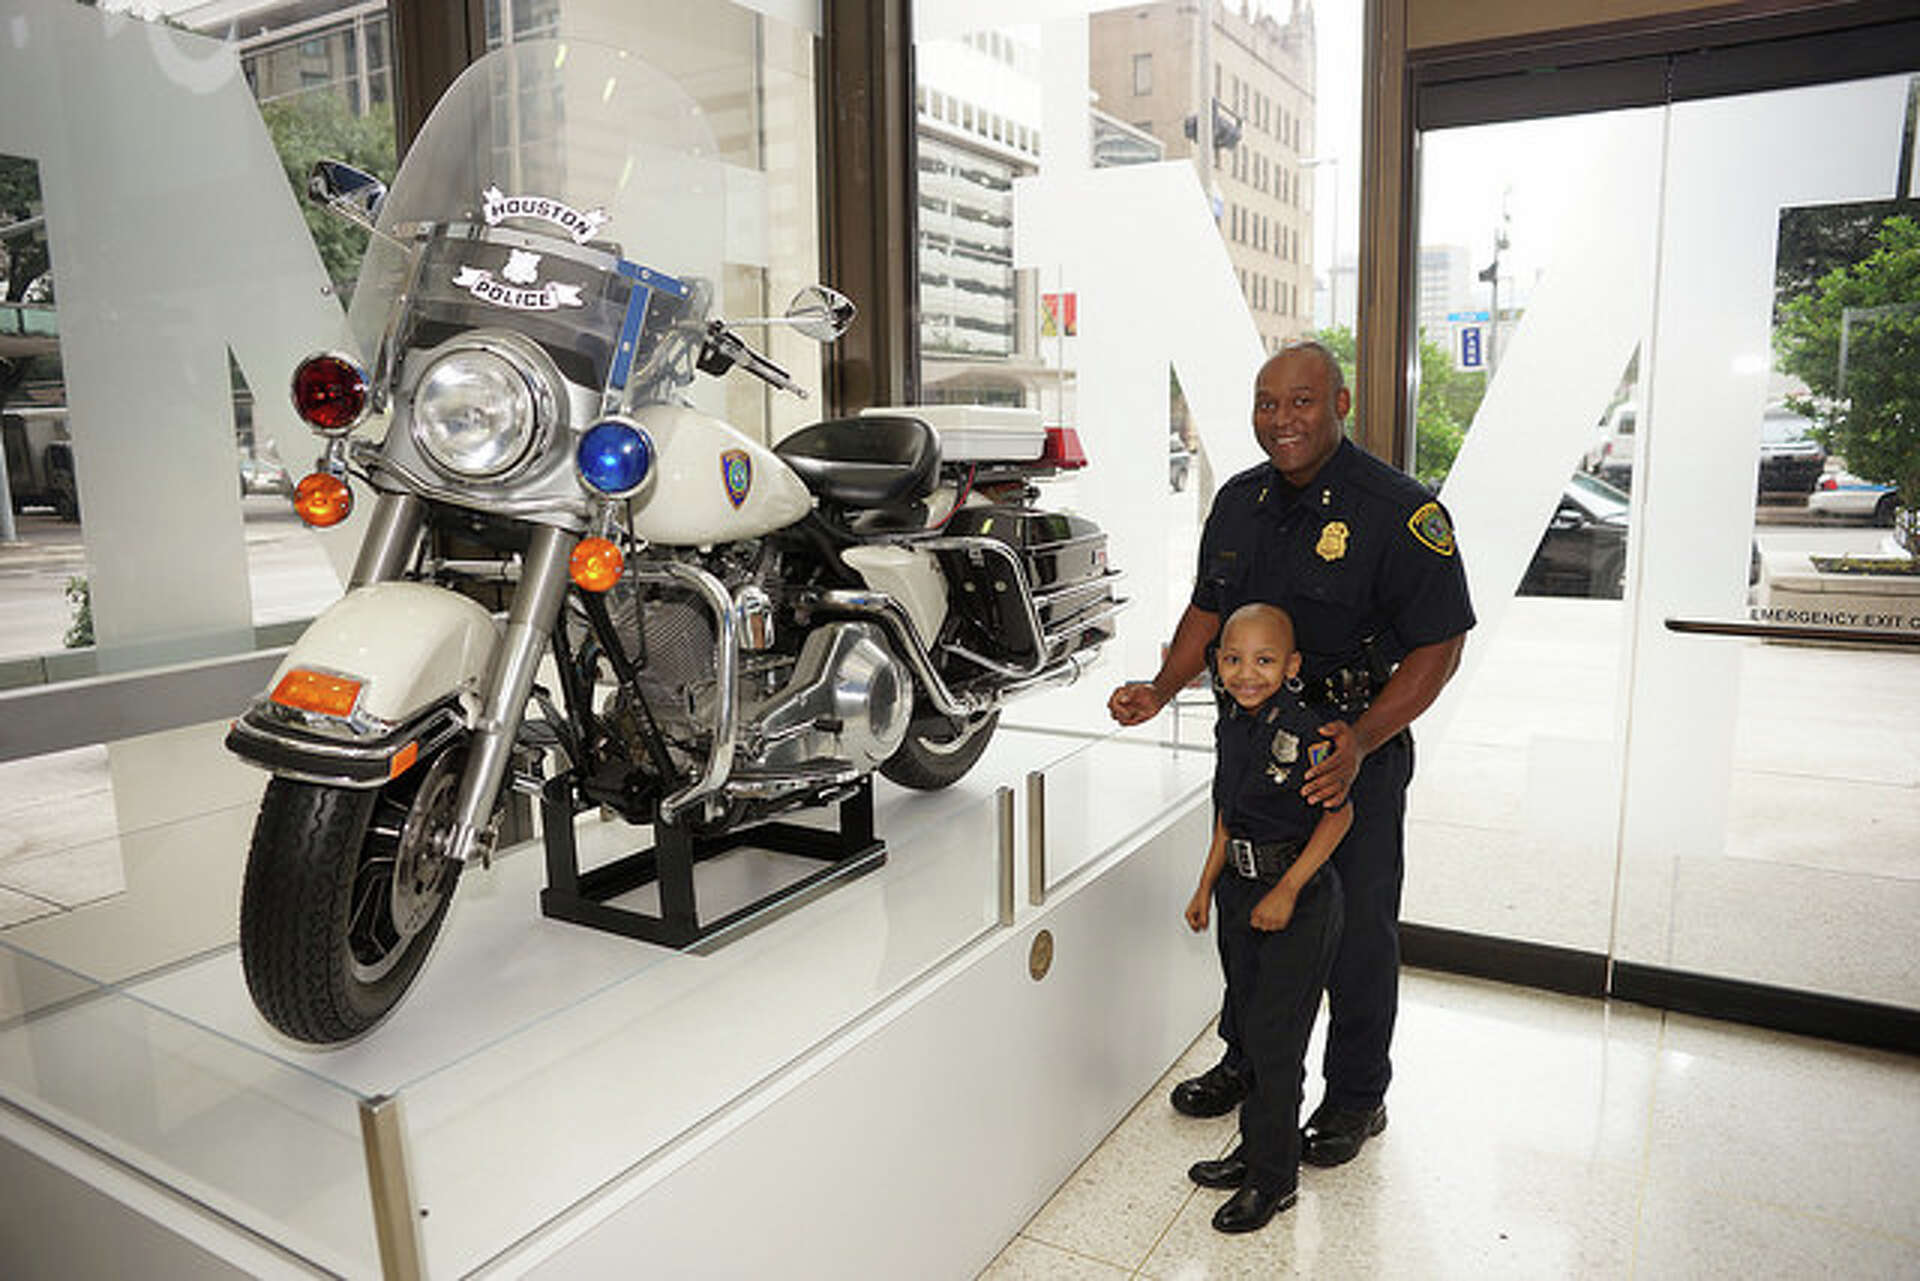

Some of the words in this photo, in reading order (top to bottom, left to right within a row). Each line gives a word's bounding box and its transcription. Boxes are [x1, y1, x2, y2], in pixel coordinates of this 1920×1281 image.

[491, 200, 591, 235] HOUSTON
[475, 281, 551, 307] POLICE
[1751, 608, 1859, 626] EMERGENCY
[1865, 613, 1903, 628] EXIT
